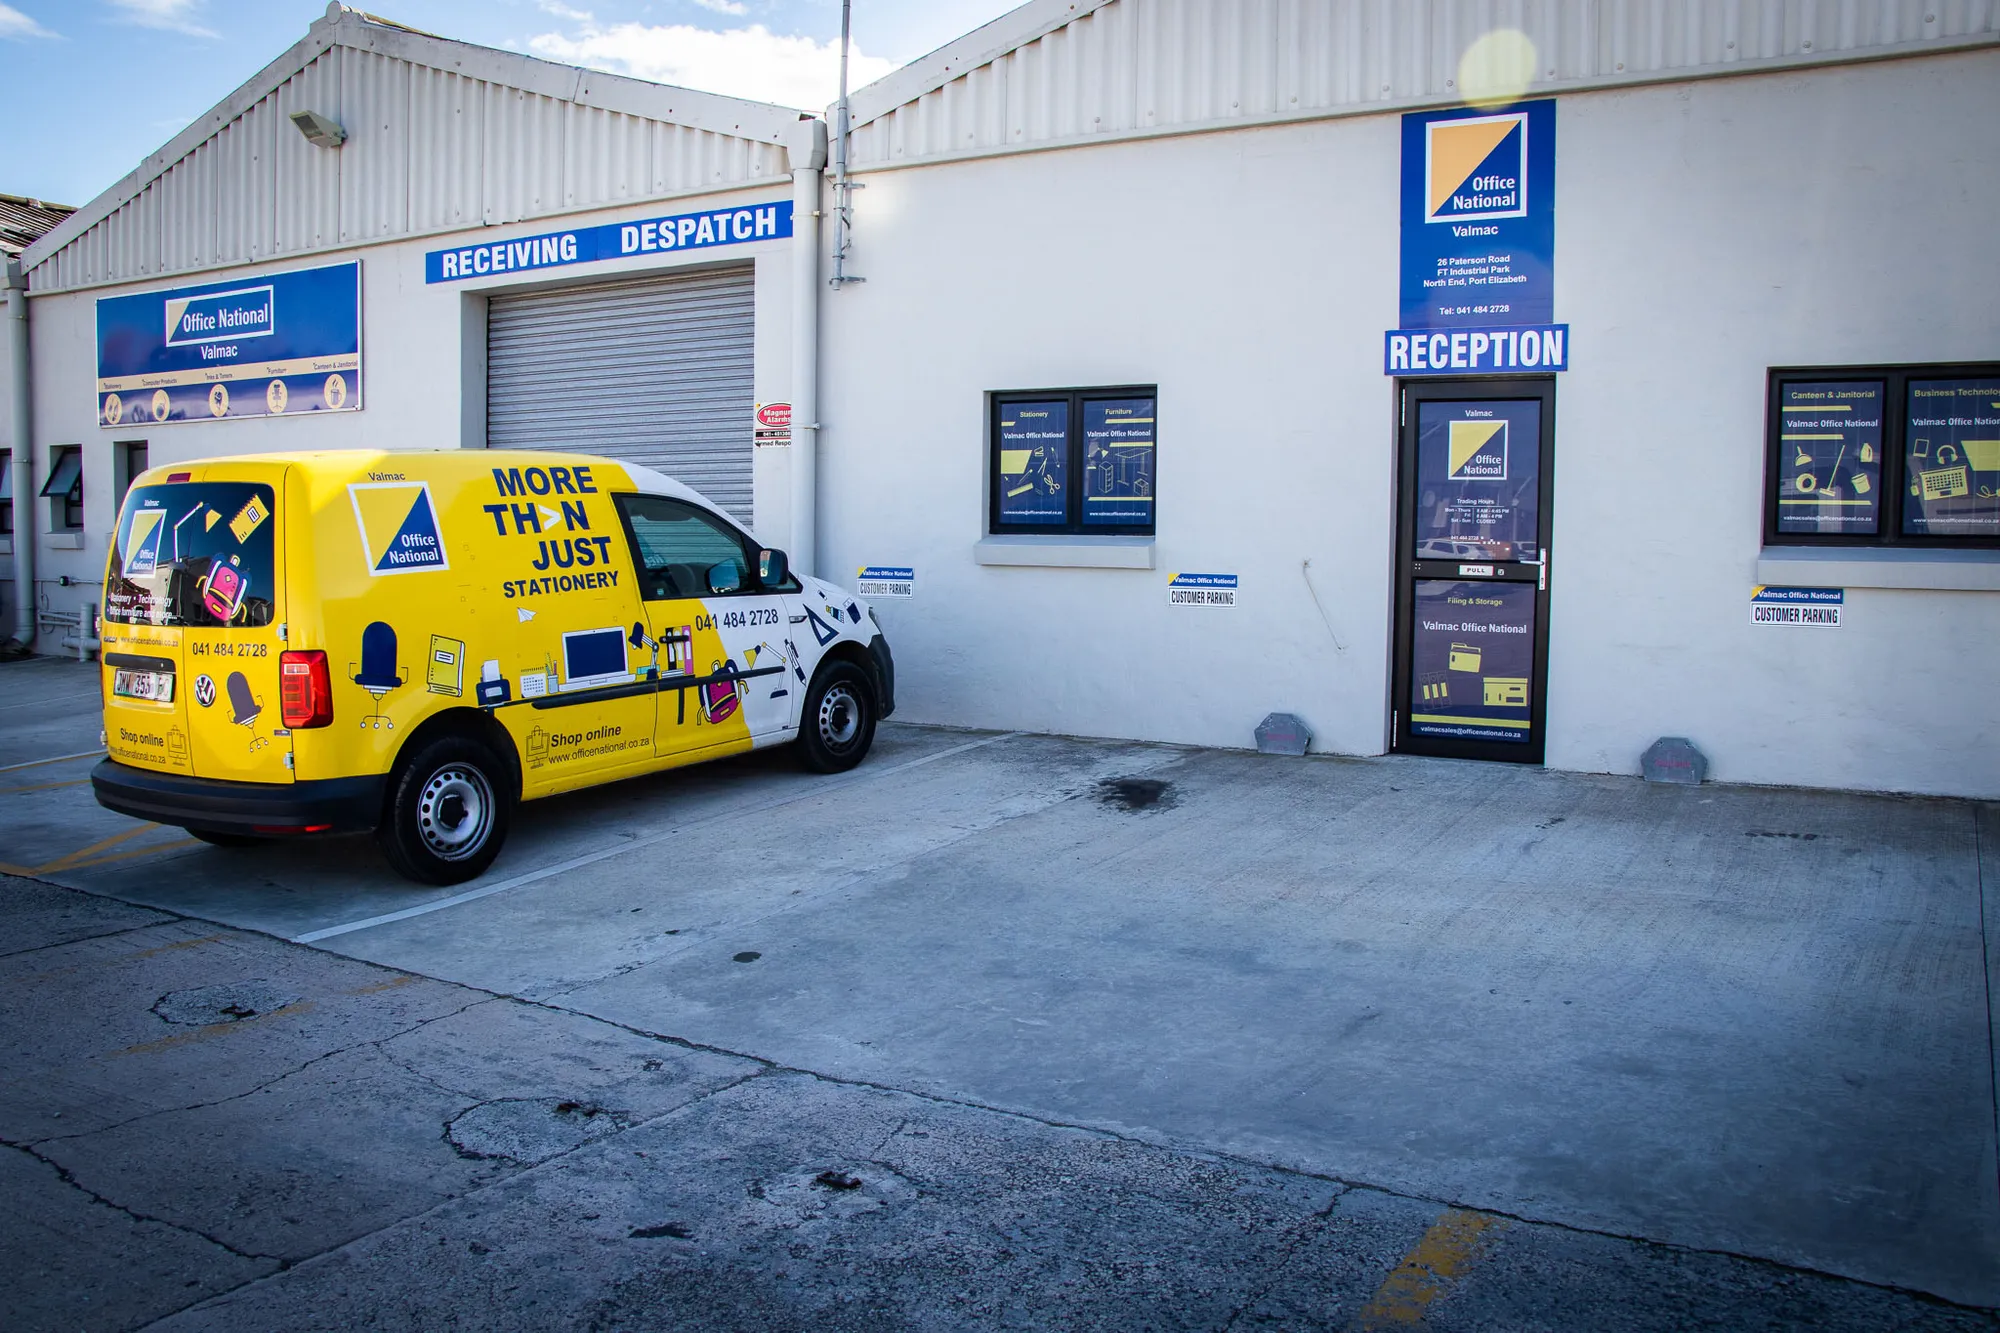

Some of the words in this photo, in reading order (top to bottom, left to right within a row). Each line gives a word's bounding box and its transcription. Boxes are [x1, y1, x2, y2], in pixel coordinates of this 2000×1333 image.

[1473, 176, 1515, 192] Office
[1453, 191, 1516, 210] National
[621, 207, 776, 253] DESPATCH
[1452, 225, 1498, 237] Valmac
[442, 234, 577, 278] RECEIVING
[1437, 258, 1447, 266] 26
[1449, 256, 1486, 265] Paterson
[1488, 255, 1510, 263] Road
[1450, 266, 1488, 276] Industrial
[1490, 266, 1510, 274] Park
[1424, 279, 1446, 287] North
[1448, 278, 1467, 287] End,
[1469, 277, 1486, 285] Port
[1488, 275, 1526, 284] Elizabeth
[1440, 307, 1454, 315] Tel:
[1457, 306, 1470, 314] 041
[1473, 305, 1487, 314] 484
[1489, 305, 1509, 313] 2728
[183, 313, 215, 333] Office
[219, 303, 268, 328] National
[201, 345, 238, 360] Valmac
[1390, 330, 1563, 370] RECEPTION
[1791, 391, 1825, 399] Canteen
[1836, 390, 1875, 398] Janitorial
[1914, 389, 1954, 397] Business
[1958, 388, 2000, 396] Technolo
[1787, 420, 1818, 428] Valmac
[1820, 419, 1843, 428] Office
[1845, 418, 1878, 428] National
[1912, 418, 1946, 426] Valmac
[1948, 418, 1972, 426] Office
[1475, 455, 1501, 464] Office
[1464, 465, 1501, 474] National
[368, 472, 405, 481] Valmac
[492, 466, 598, 497] MORE
[401, 534, 435, 547] Office
[140, 550, 154, 559] Office
[389, 548, 438, 564] National
[532, 536, 611, 571] JUST
[503, 570, 619, 598] STATIONERY
[860, 582, 888, 594] CUSTOMER
[889, 583, 910, 595] PARKING
[1172, 591, 1205, 604] CUSTOMER
[1207, 592, 1233, 604] PARKING
[1448, 597, 1467, 605] Filing
[1475, 598, 1502, 606] Storage
[1811, 592, 1840, 600] National
[696, 614, 718, 631] 041
[724, 611, 746, 628] 484
[749, 609, 779, 626] 2728
[1755, 607, 1799, 622] CUSTOMER
[1802, 608, 1838, 623] PARKING
[1423, 621, 1459, 631] Valmac
[1461, 622, 1486, 632] Office
[1489, 624, 1527, 633] National
[192, 643, 210, 655] 041
[214, 643, 234, 656] 484
[238, 644, 267, 657] 2728
[121, 728, 138, 745] Shop
[140, 733, 164, 747] online
[551, 733, 582, 747] Shop
[586, 726, 621, 741] online
[1420, 726, 1521, 738] valmacsales@officenational.co.za
[549, 738, 650, 764] www.officenational.co.za
